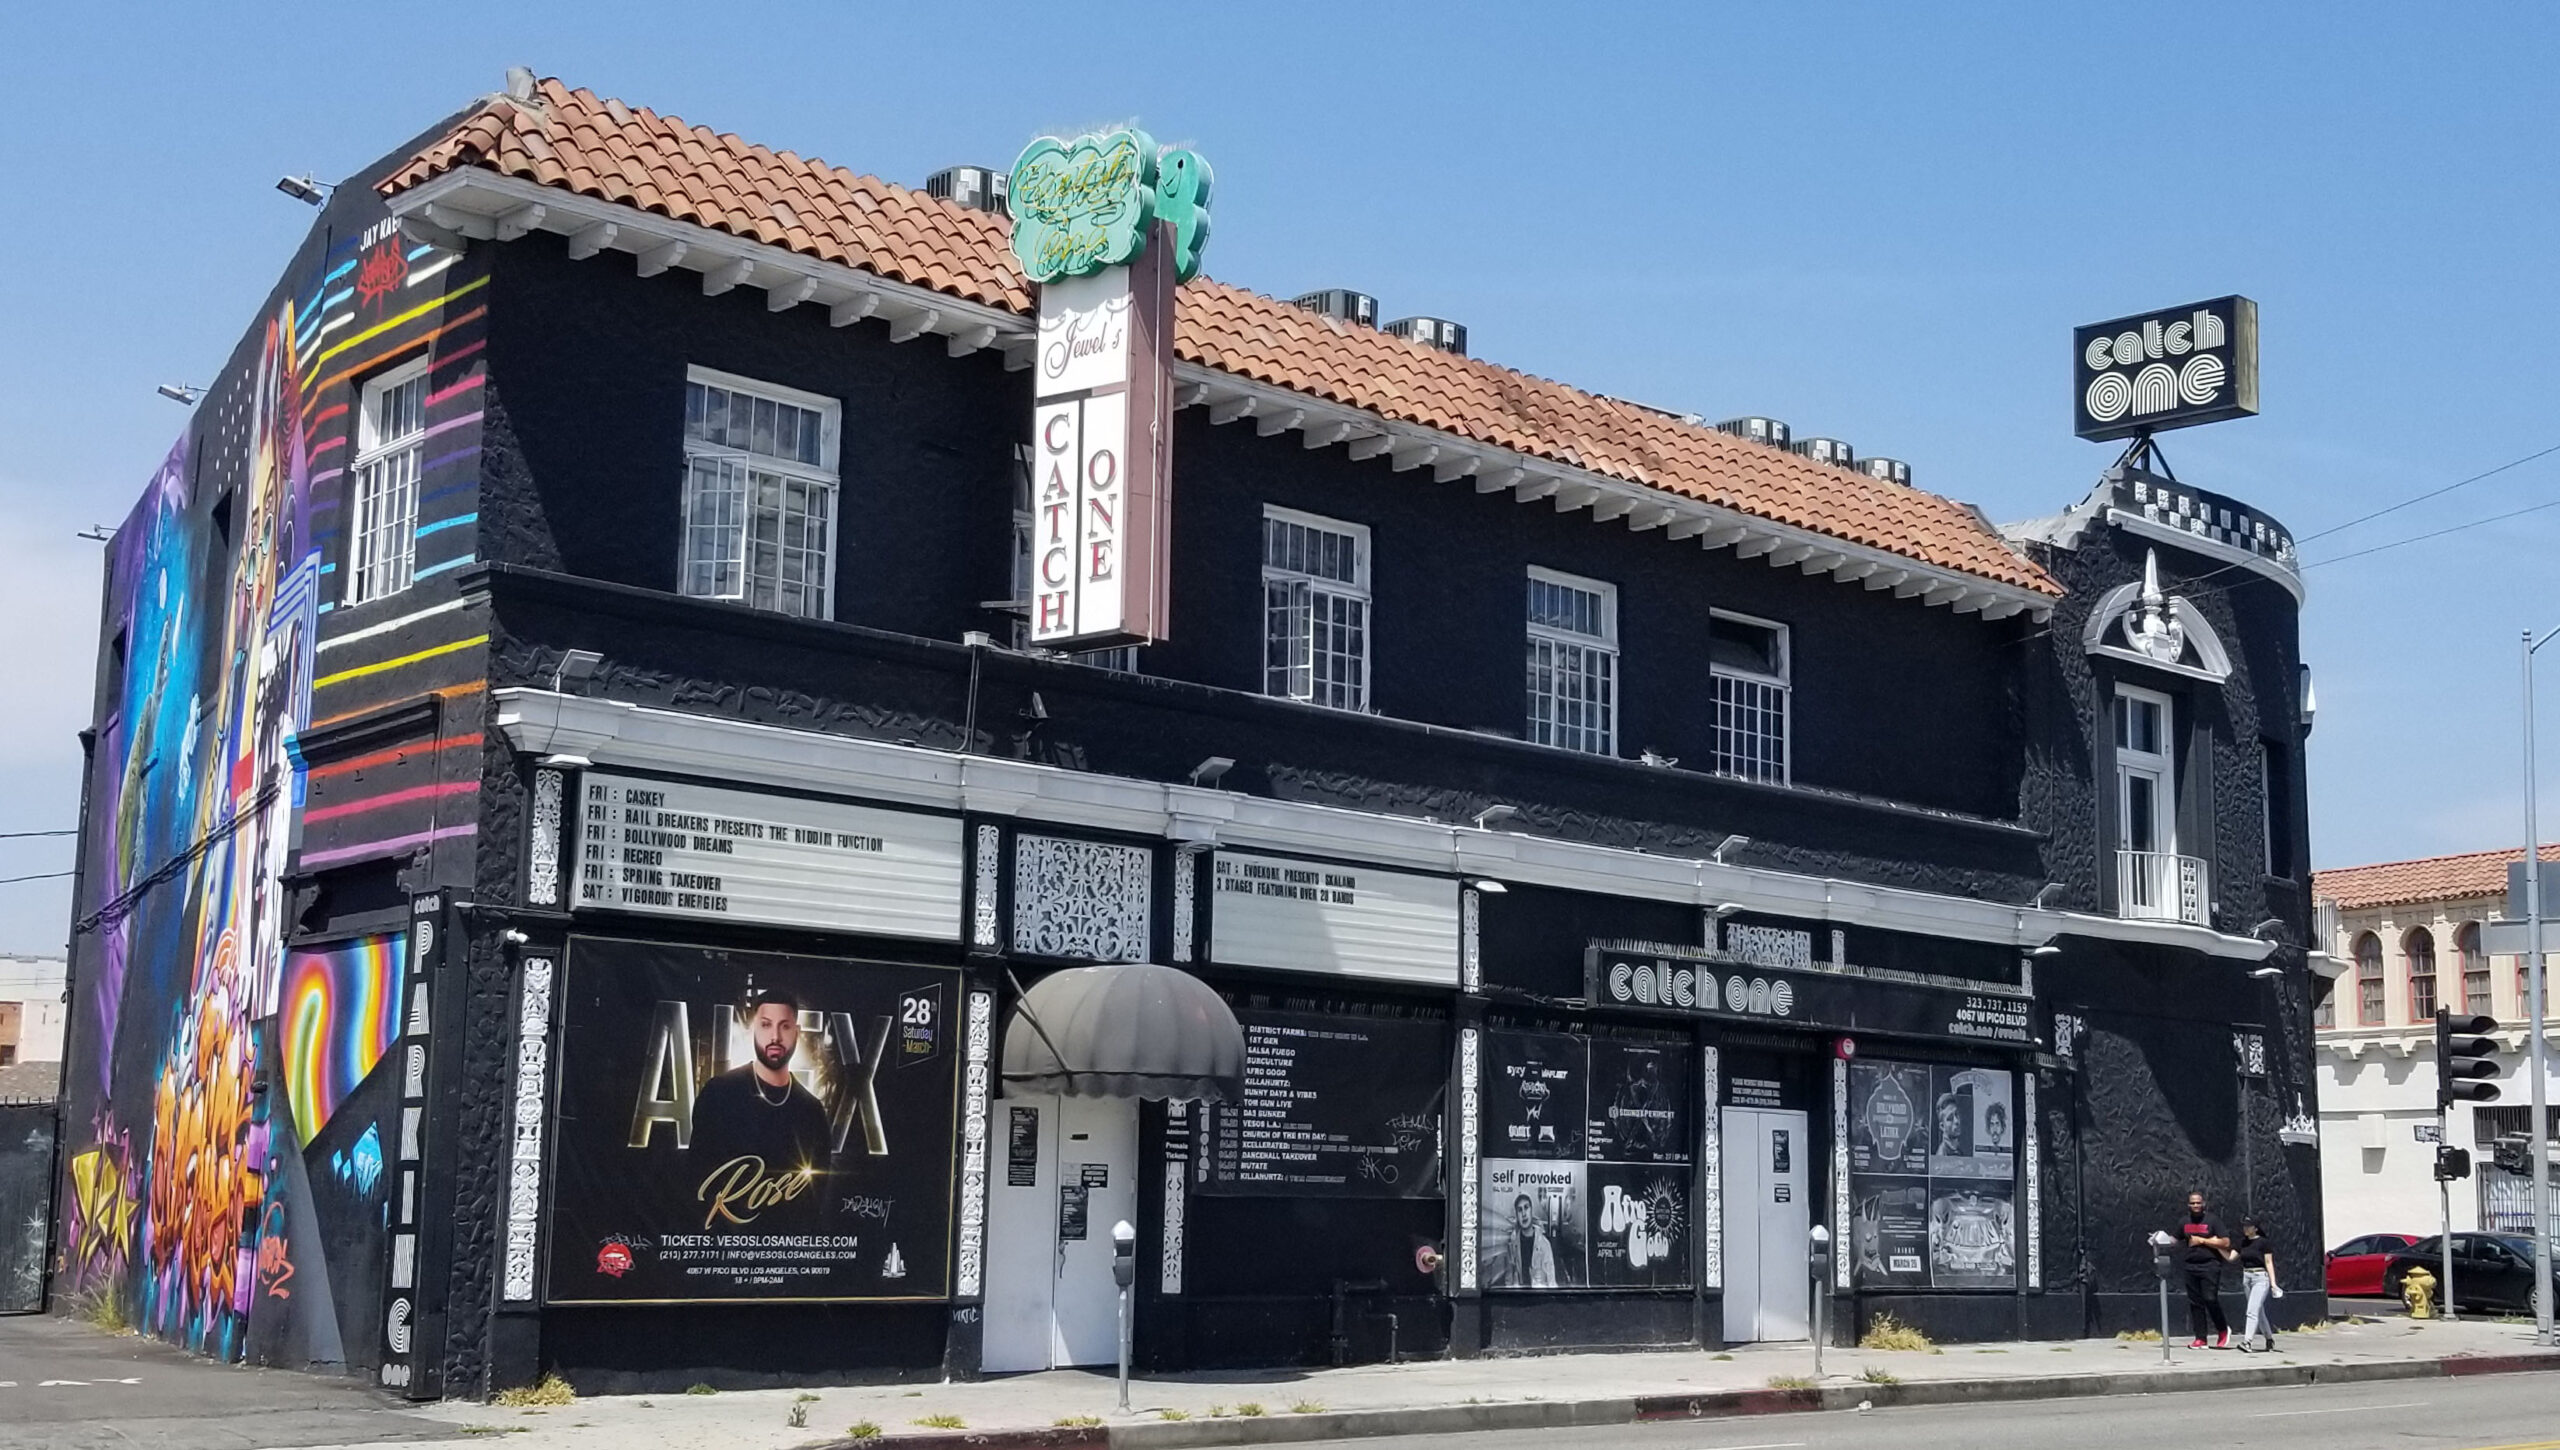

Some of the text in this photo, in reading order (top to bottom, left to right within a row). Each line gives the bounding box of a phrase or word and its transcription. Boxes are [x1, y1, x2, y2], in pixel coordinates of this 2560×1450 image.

[360, 223, 379, 252] JAY
[1044, 318, 1123, 380] Jewel's
[2086, 309, 2225, 371] catch
[2086, 354, 2226, 422] one
[1038, 413, 1070, 635] CATCH
[1086, 449, 1118, 583] ONE
[590, 785, 607, 802] FRI
[626, 789, 665, 807] CASKEY
[587, 824, 605, 840] FRI
[625, 828, 686, 849] BOLLYWOOD
[693, 836, 733, 854] DREAMS
[588, 805, 606, 820] FRI
[625, 808, 651, 826] RAIL
[657, 812, 709, 832] BREAKERS
[714, 819, 763, 838] PRESENTS
[769, 826, 788, 841] THE
[795, 829, 832, 847] RIDDIM
[837, 834, 883, 852] FUNCTION
[586, 844, 604, 860] FRI
[623, 848, 662, 866] RECREO
[584, 863, 603, 880] FRI
[623, 867, 663, 886] SPRING
[670, 872, 721, 891] TAKEOVER
[1216, 861, 1231, 875] SAT
[1284, 869, 1319, 885] PRESENTS
[582, 884, 603, 899] SAT
[622, 888, 673, 906] VIGOROUS
[678, 893, 728, 912] ENERGIES
[1216, 878, 1222, 891] 3
[1225, 878, 1253, 894] STAGES
[1257, 882, 1297, 899] FEATURING
[1300, 887, 1318, 901] OVER
[1332, 890, 1354, 905] BANDS
[1609, 960, 1793, 1016] catch one
[1956, 1009, 2028, 1027] 4067 W PICO BLVD
[1966, 996, 2028, 1014] 323.737.1159
[903, 1026, 933, 1042] Saturday
[627, 1000, 893, 1156] AX
[388, 920, 434, 1353] PARKING
[697, 1154, 812, 1230] Rose
[1492, 1169, 1572, 1187] self provoked
[660, 1234, 714, 1247] TICKETS:
[716, 1235, 858, 1248] VESOSLOSANGELES.COM
[659, 1250, 681, 1261] (213)
[682, 1250, 720, 1260] 277.7171
[727, 1250, 857, 1260] INFO@VESOSLOSANGELES.COM
